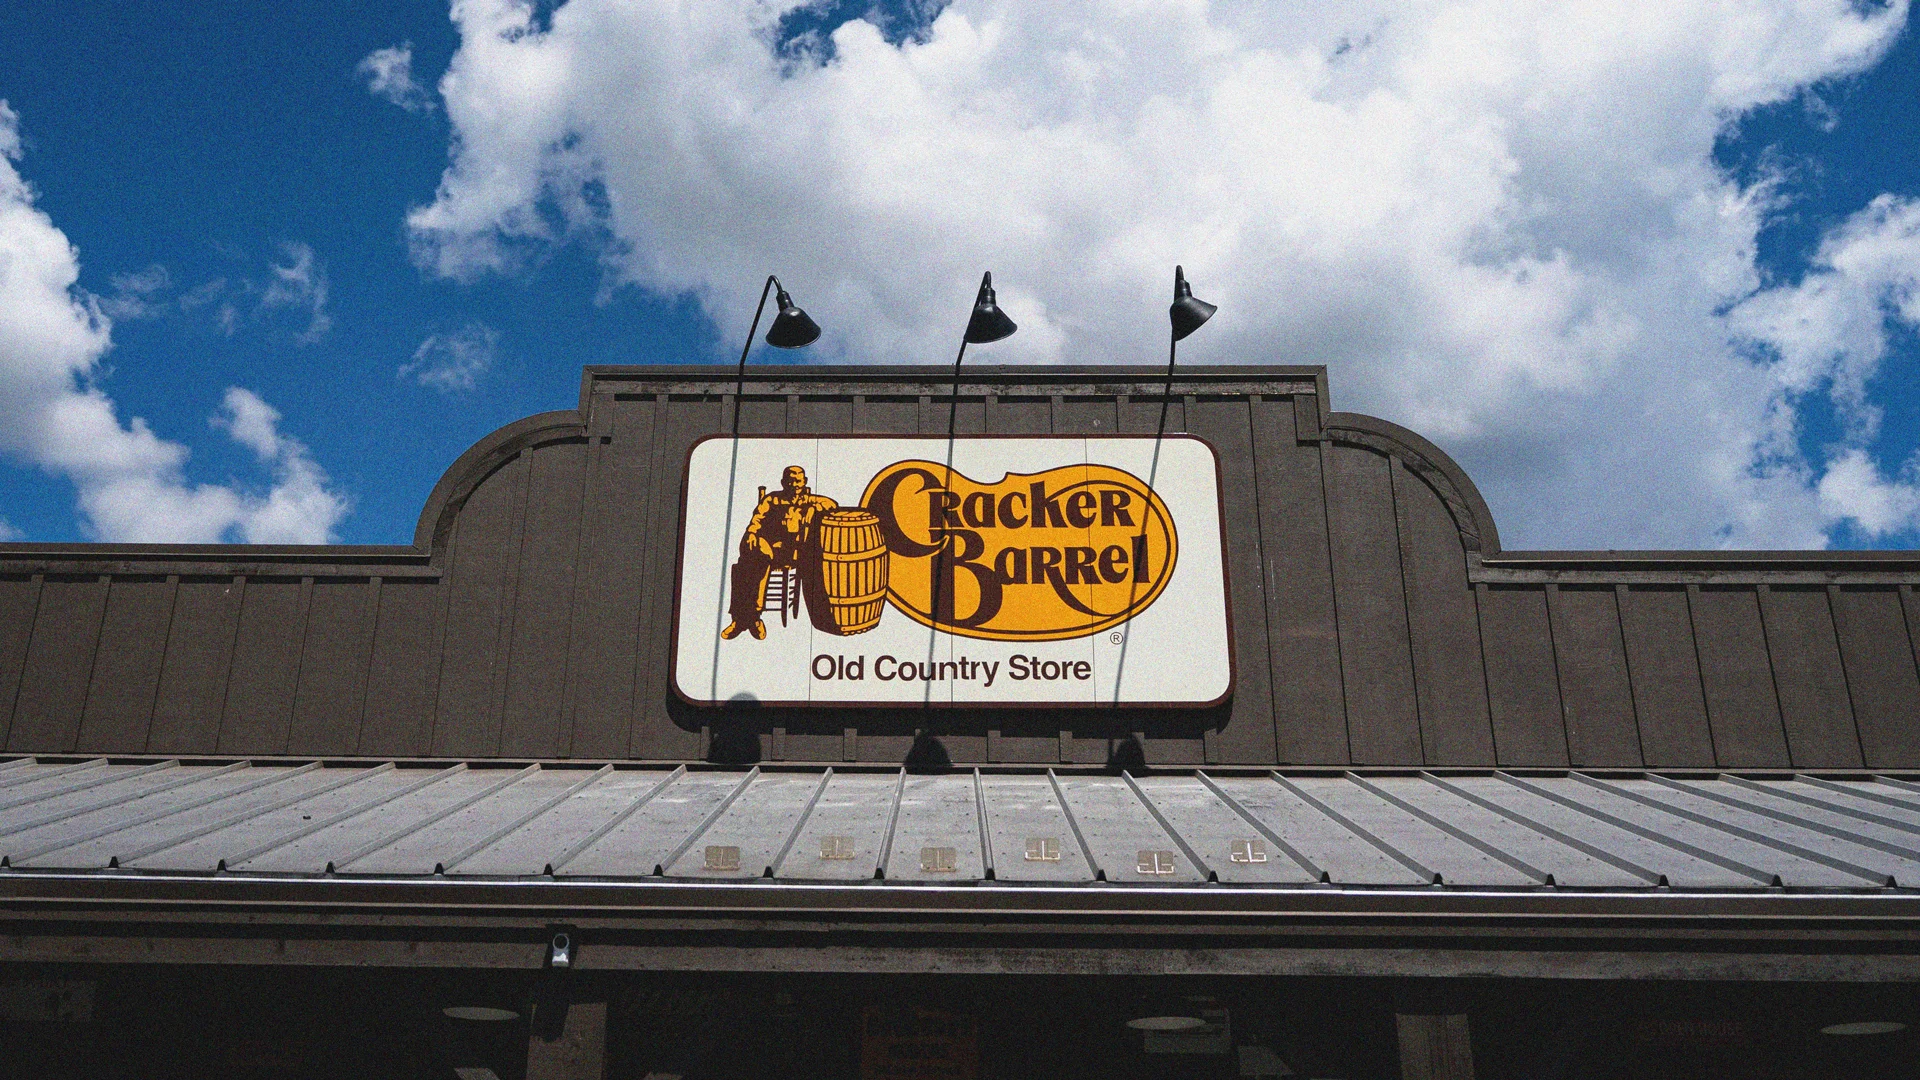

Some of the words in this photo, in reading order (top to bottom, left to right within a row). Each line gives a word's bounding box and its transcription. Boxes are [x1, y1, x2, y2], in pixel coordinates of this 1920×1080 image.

[811, 654, 865, 681] Old
[874, 655, 1000, 688] Country
[1008, 654, 1092, 681] Store
